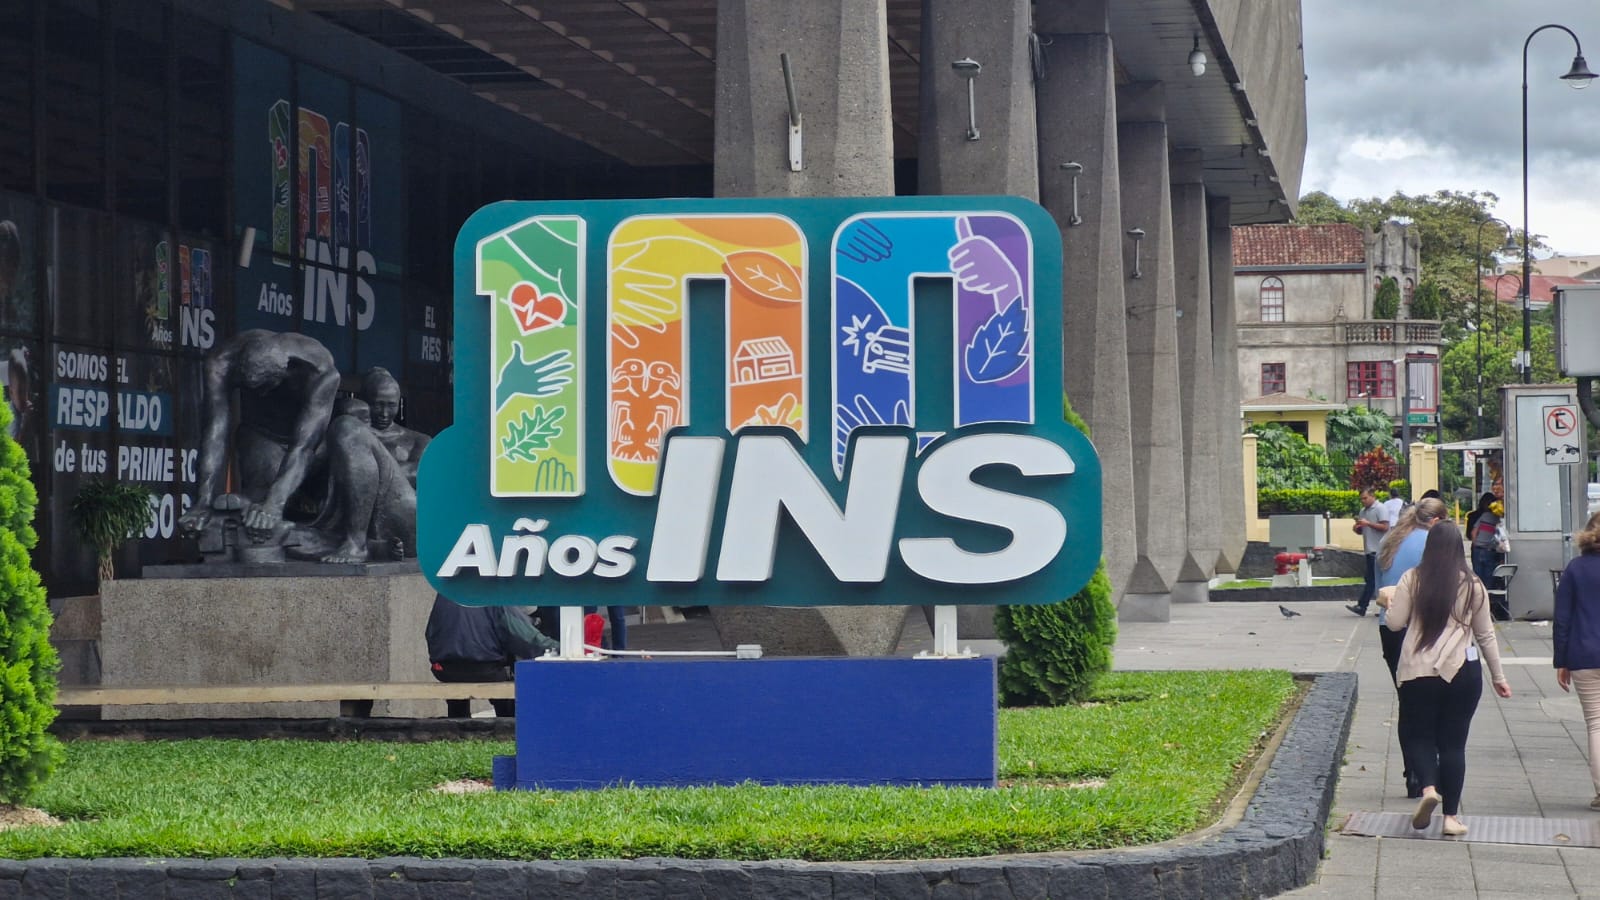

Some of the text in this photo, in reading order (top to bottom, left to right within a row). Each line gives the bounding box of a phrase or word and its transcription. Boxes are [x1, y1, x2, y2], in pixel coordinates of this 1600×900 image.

[257, 237, 376, 332] Años INS
[57, 350, 108, 382] SOMOS
[476, 211, 1034, 498] 100
[54, 440, 76, 473] de
[81, 443, 107, 474] tus
[436, 433, 1076, 586] Años INS
